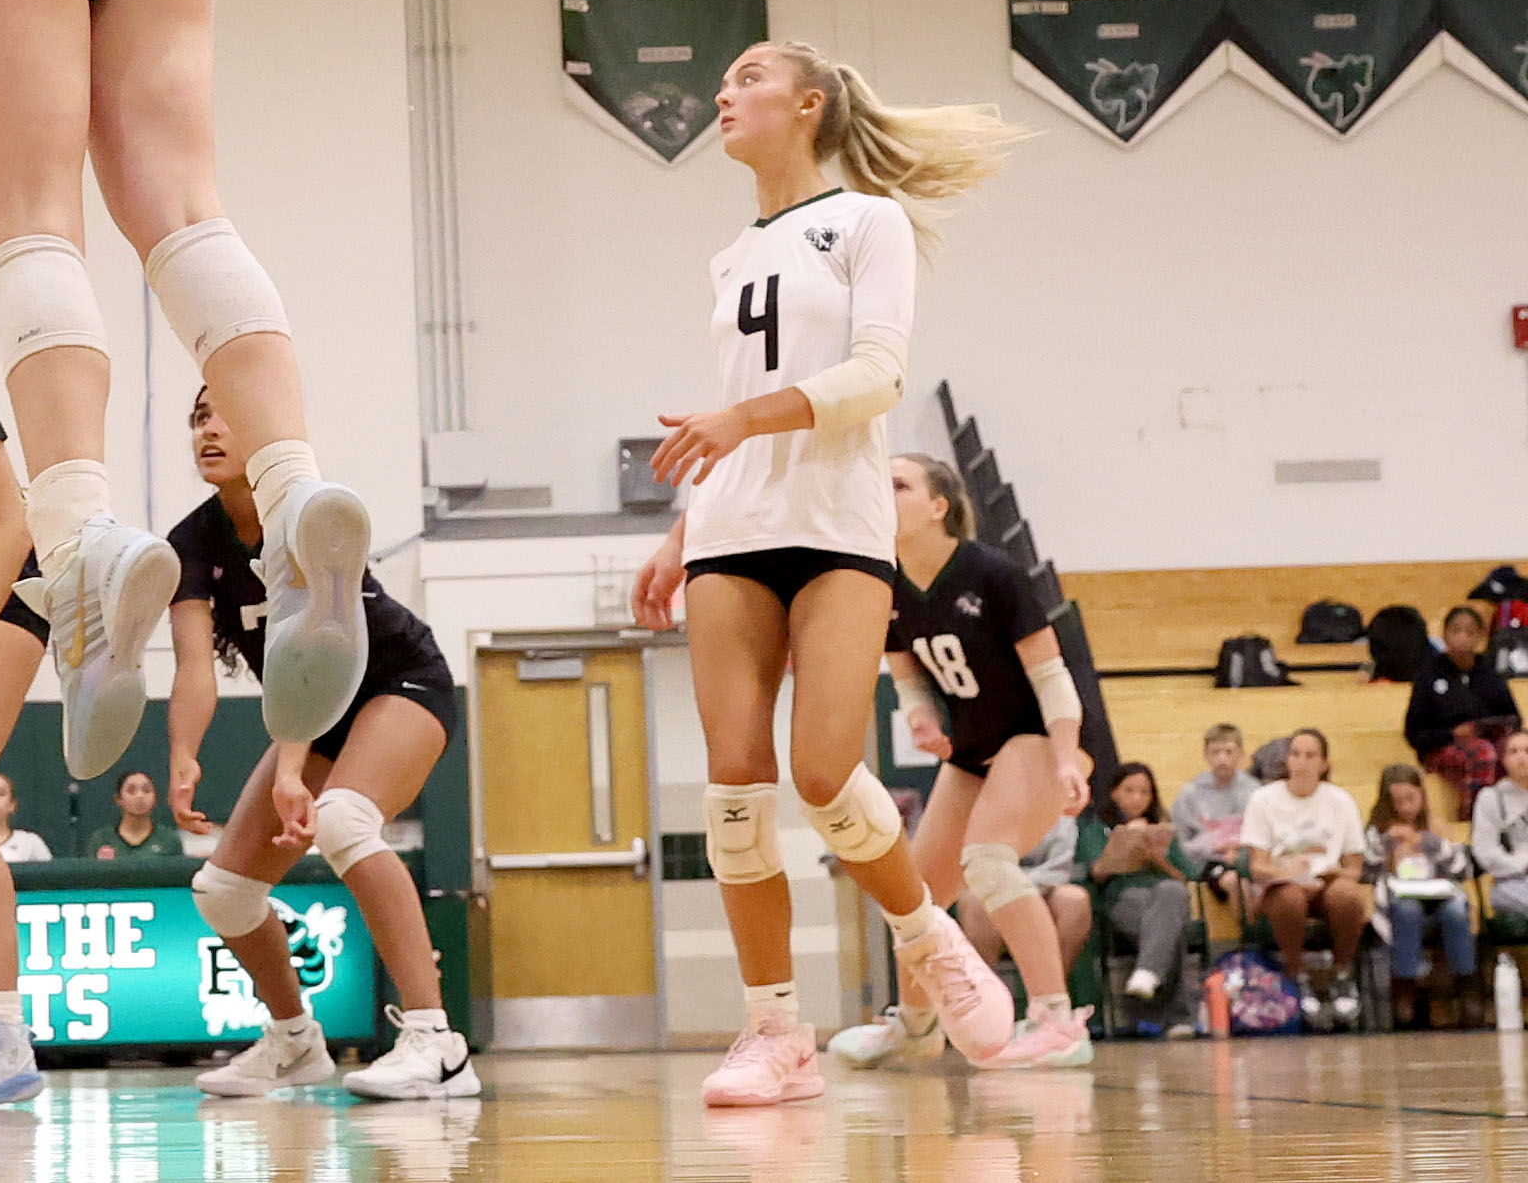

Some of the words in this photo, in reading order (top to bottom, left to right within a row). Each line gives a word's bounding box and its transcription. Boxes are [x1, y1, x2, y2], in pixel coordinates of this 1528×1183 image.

[737, 274, 780, 371] 4
[912, 633, 981, 699] 18
[16, 902, 156, 970] THE
